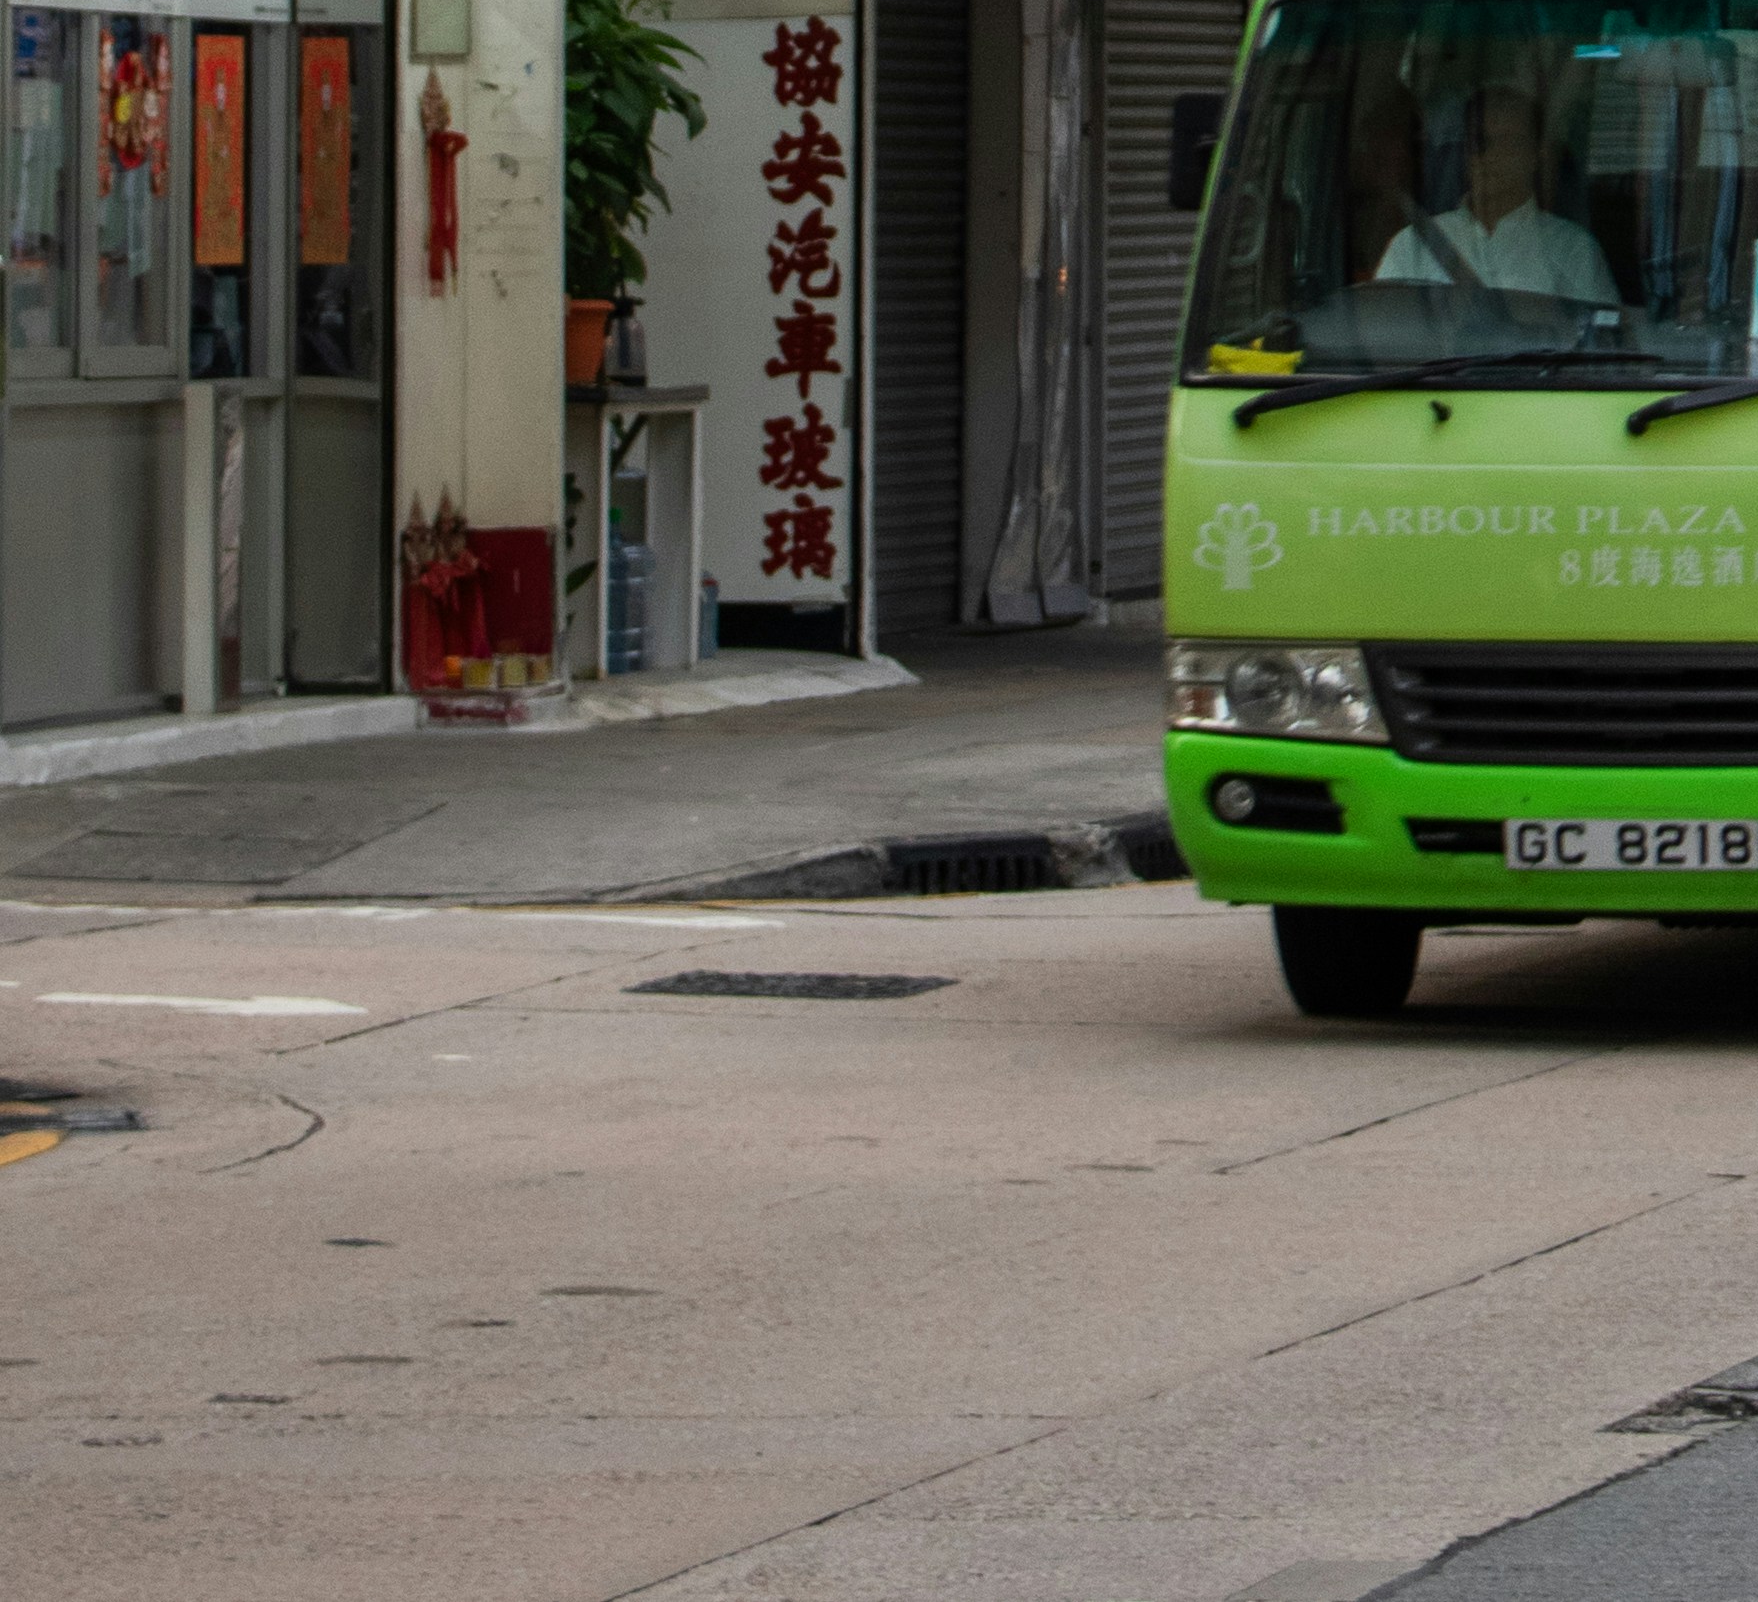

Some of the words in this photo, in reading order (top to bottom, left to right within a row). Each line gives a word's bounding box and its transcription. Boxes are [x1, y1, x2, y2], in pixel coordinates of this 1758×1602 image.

[759, 14, 847, 580] 協安汽車玻璃
[1307, 504, 1558, 536] HARBOUR
[1576, 504, 1747, 535] PLAZA
[1516, 822, 1585, 865] GC
[1617, 822, 1751, 865] 8218
